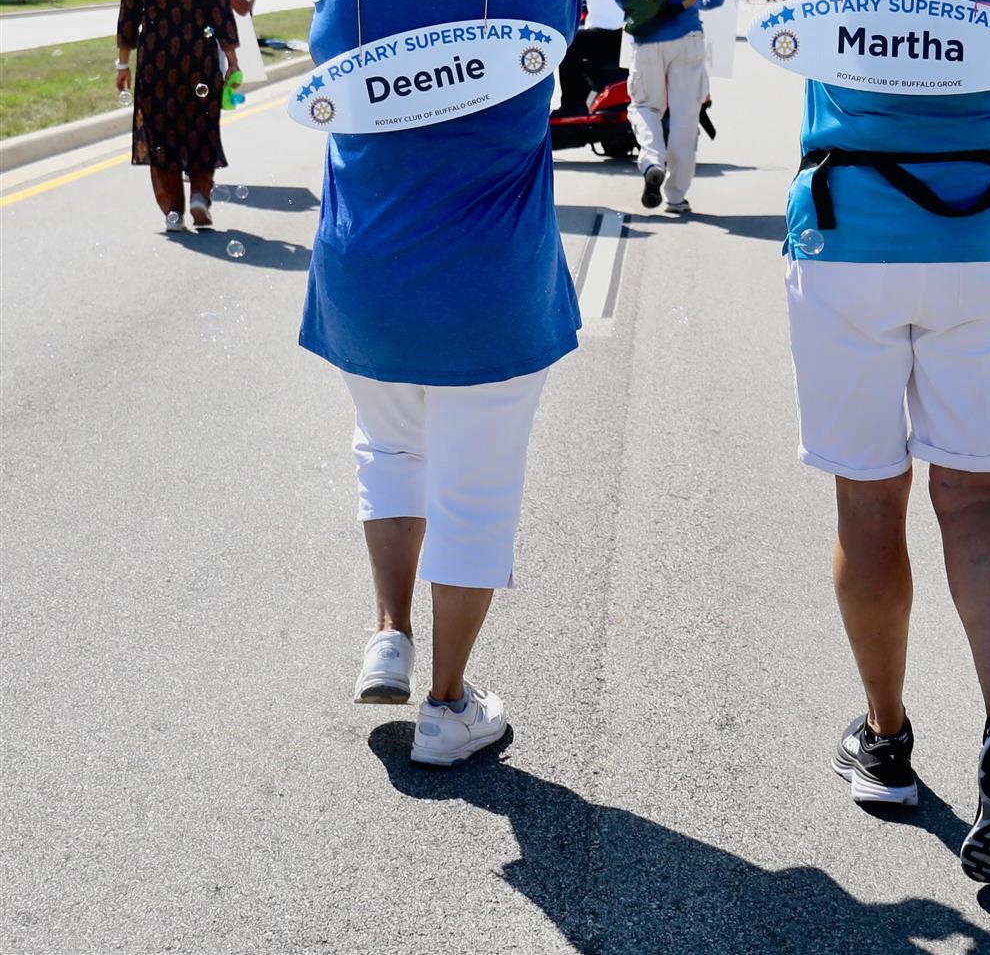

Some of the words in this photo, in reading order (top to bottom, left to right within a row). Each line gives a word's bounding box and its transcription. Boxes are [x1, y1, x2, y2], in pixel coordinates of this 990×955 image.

[327, 41, 398, 81] ROTARY
[404, 25, 513, 52] SUPERSTAR
[838, 26, 964, 62] Martha
[365, 56, 485, 104] Deenie
[837, 72, 867, 83] ROTARY
[868, 78, 888, 86] CLUB
[889, 79, 899, 87] OF
[901, 80, 935, 88] BUFFALO
[937, 80, 962, 88] GROVE
[375, 117, 403, 127] ROTARY
[403, 113, 423, 123] CLUB
[424, 111, 433, 119] OF
[435, 103, 465, 117] BUFFALO
[467, 94, 490, 109] GROVE
